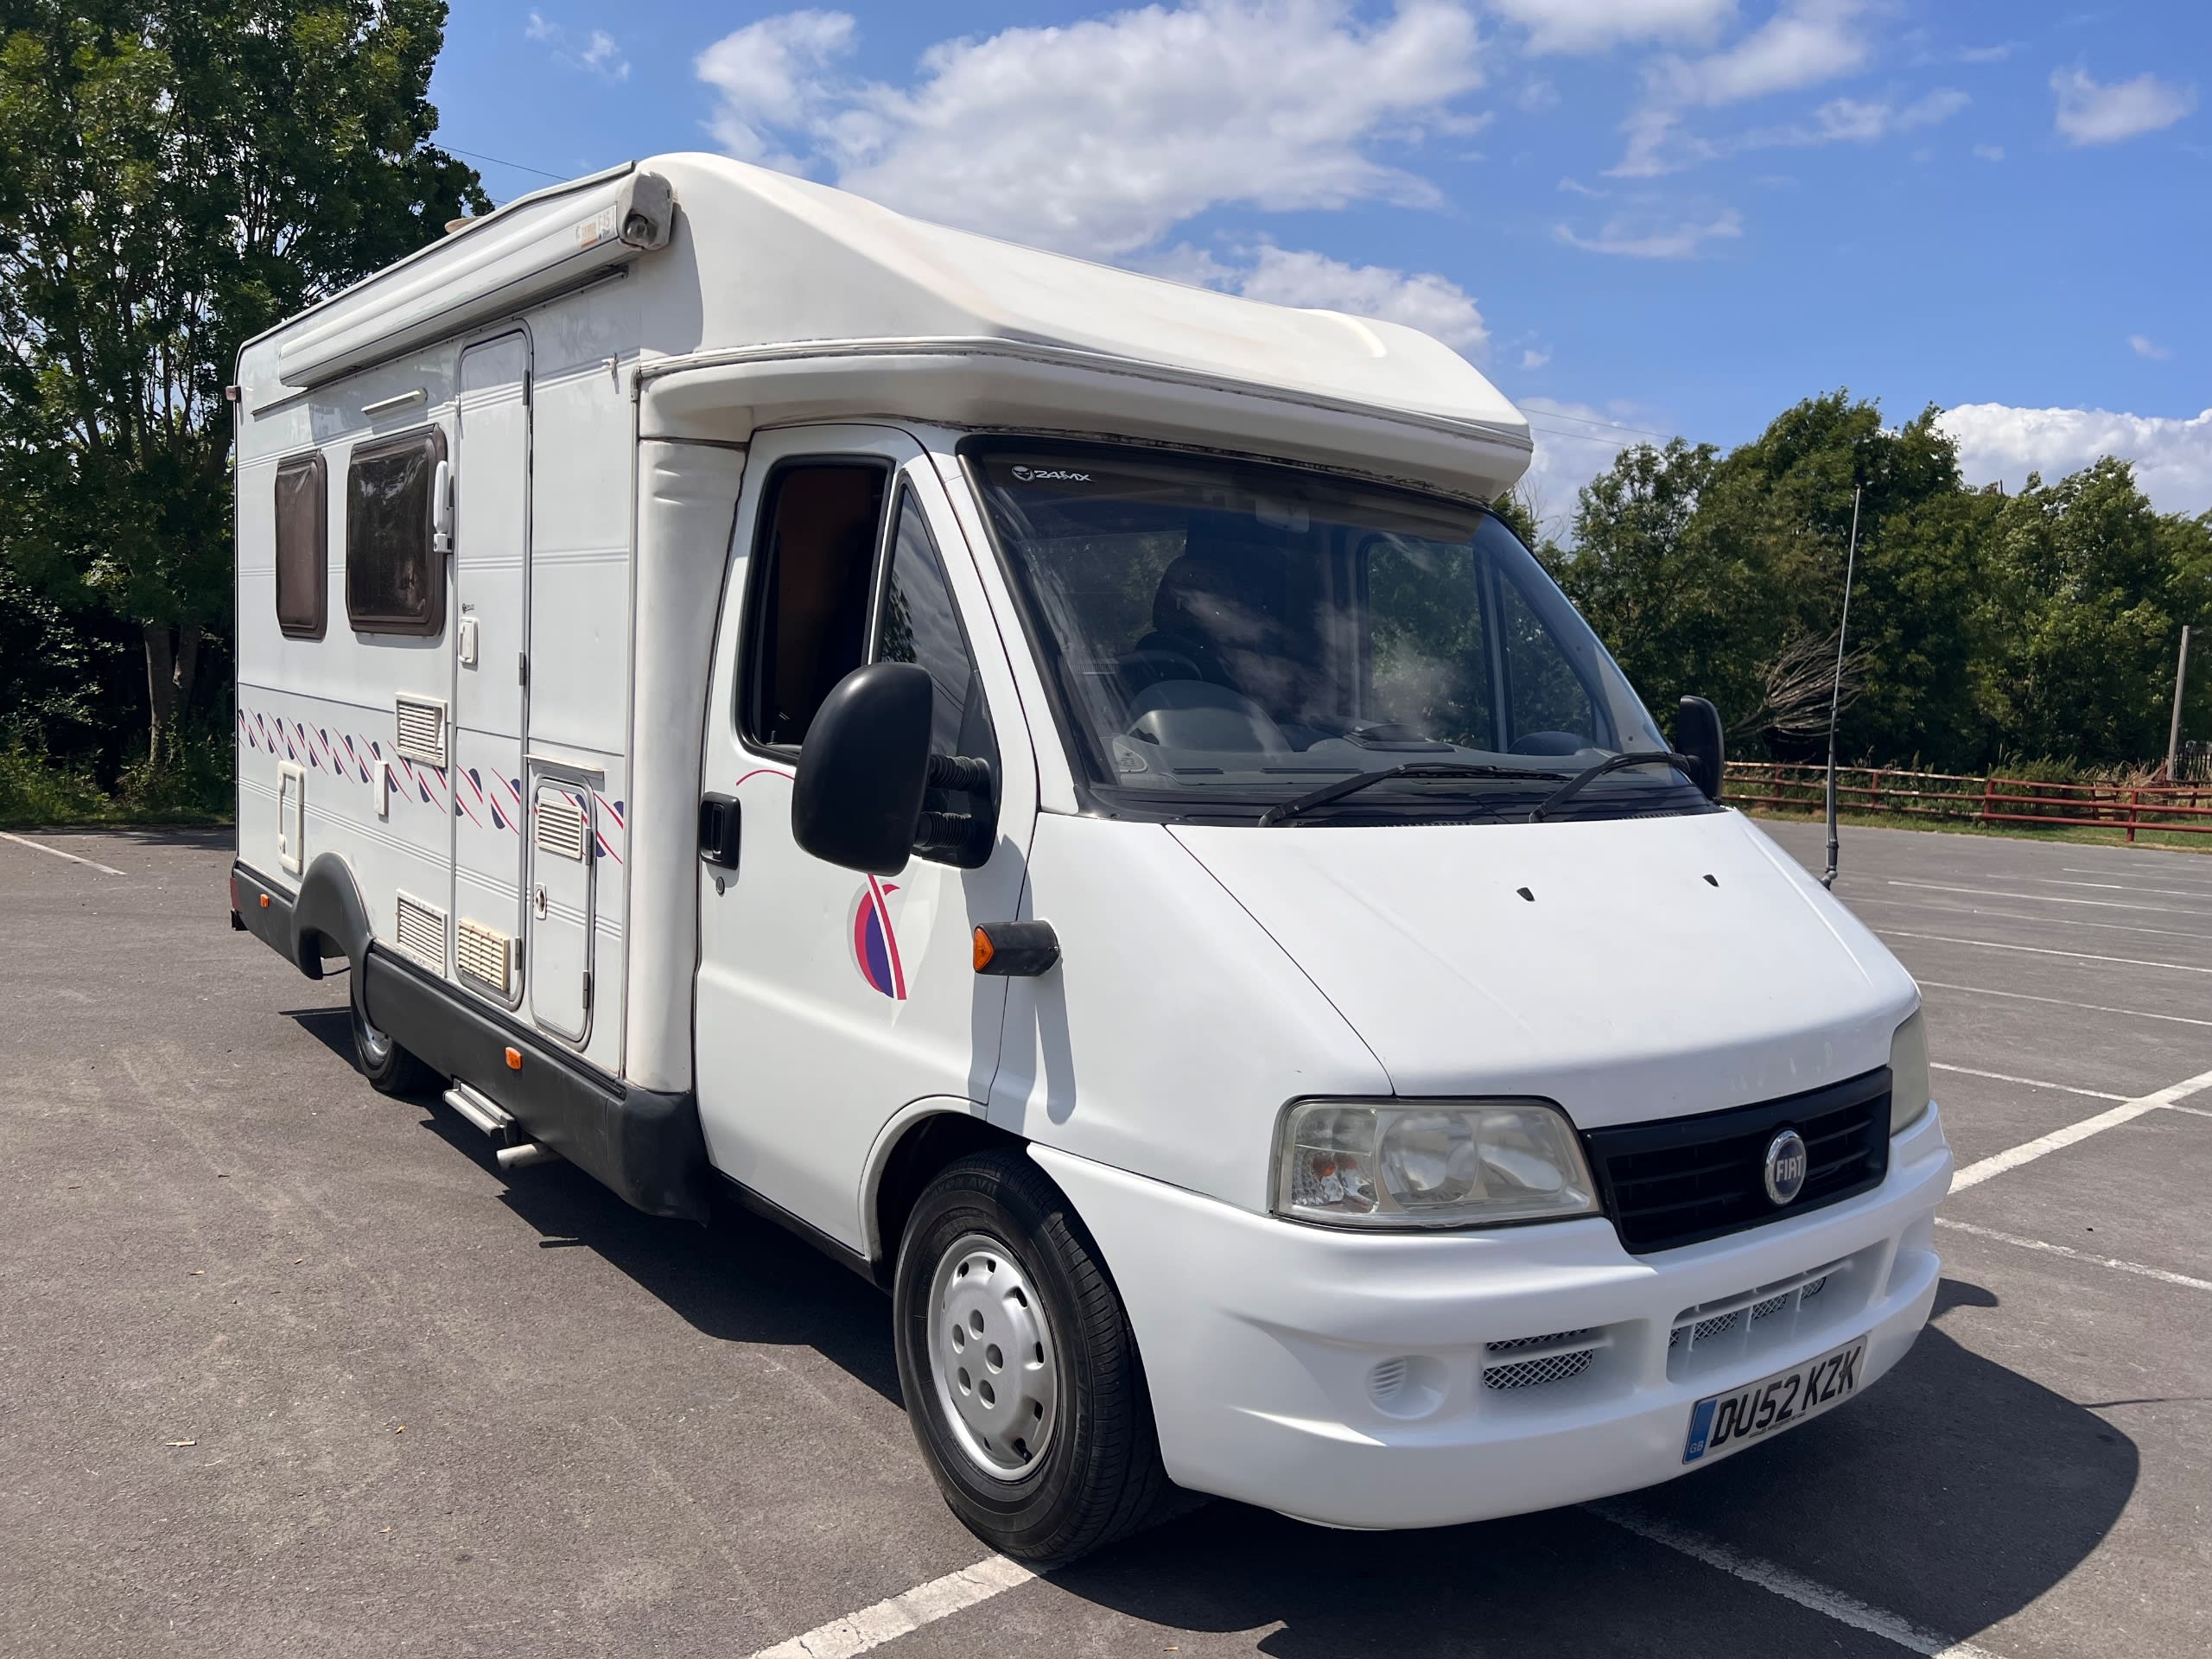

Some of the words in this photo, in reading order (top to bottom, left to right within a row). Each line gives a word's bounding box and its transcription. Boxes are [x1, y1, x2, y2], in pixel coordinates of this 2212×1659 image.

[1776, 1155, 1803, 1183] FIAT
[1709, 1374, 1801, 1448] DU52
[1802, 1346, 1861, 1411] KZK
[1689, 1440, 1704, 1454] GB
